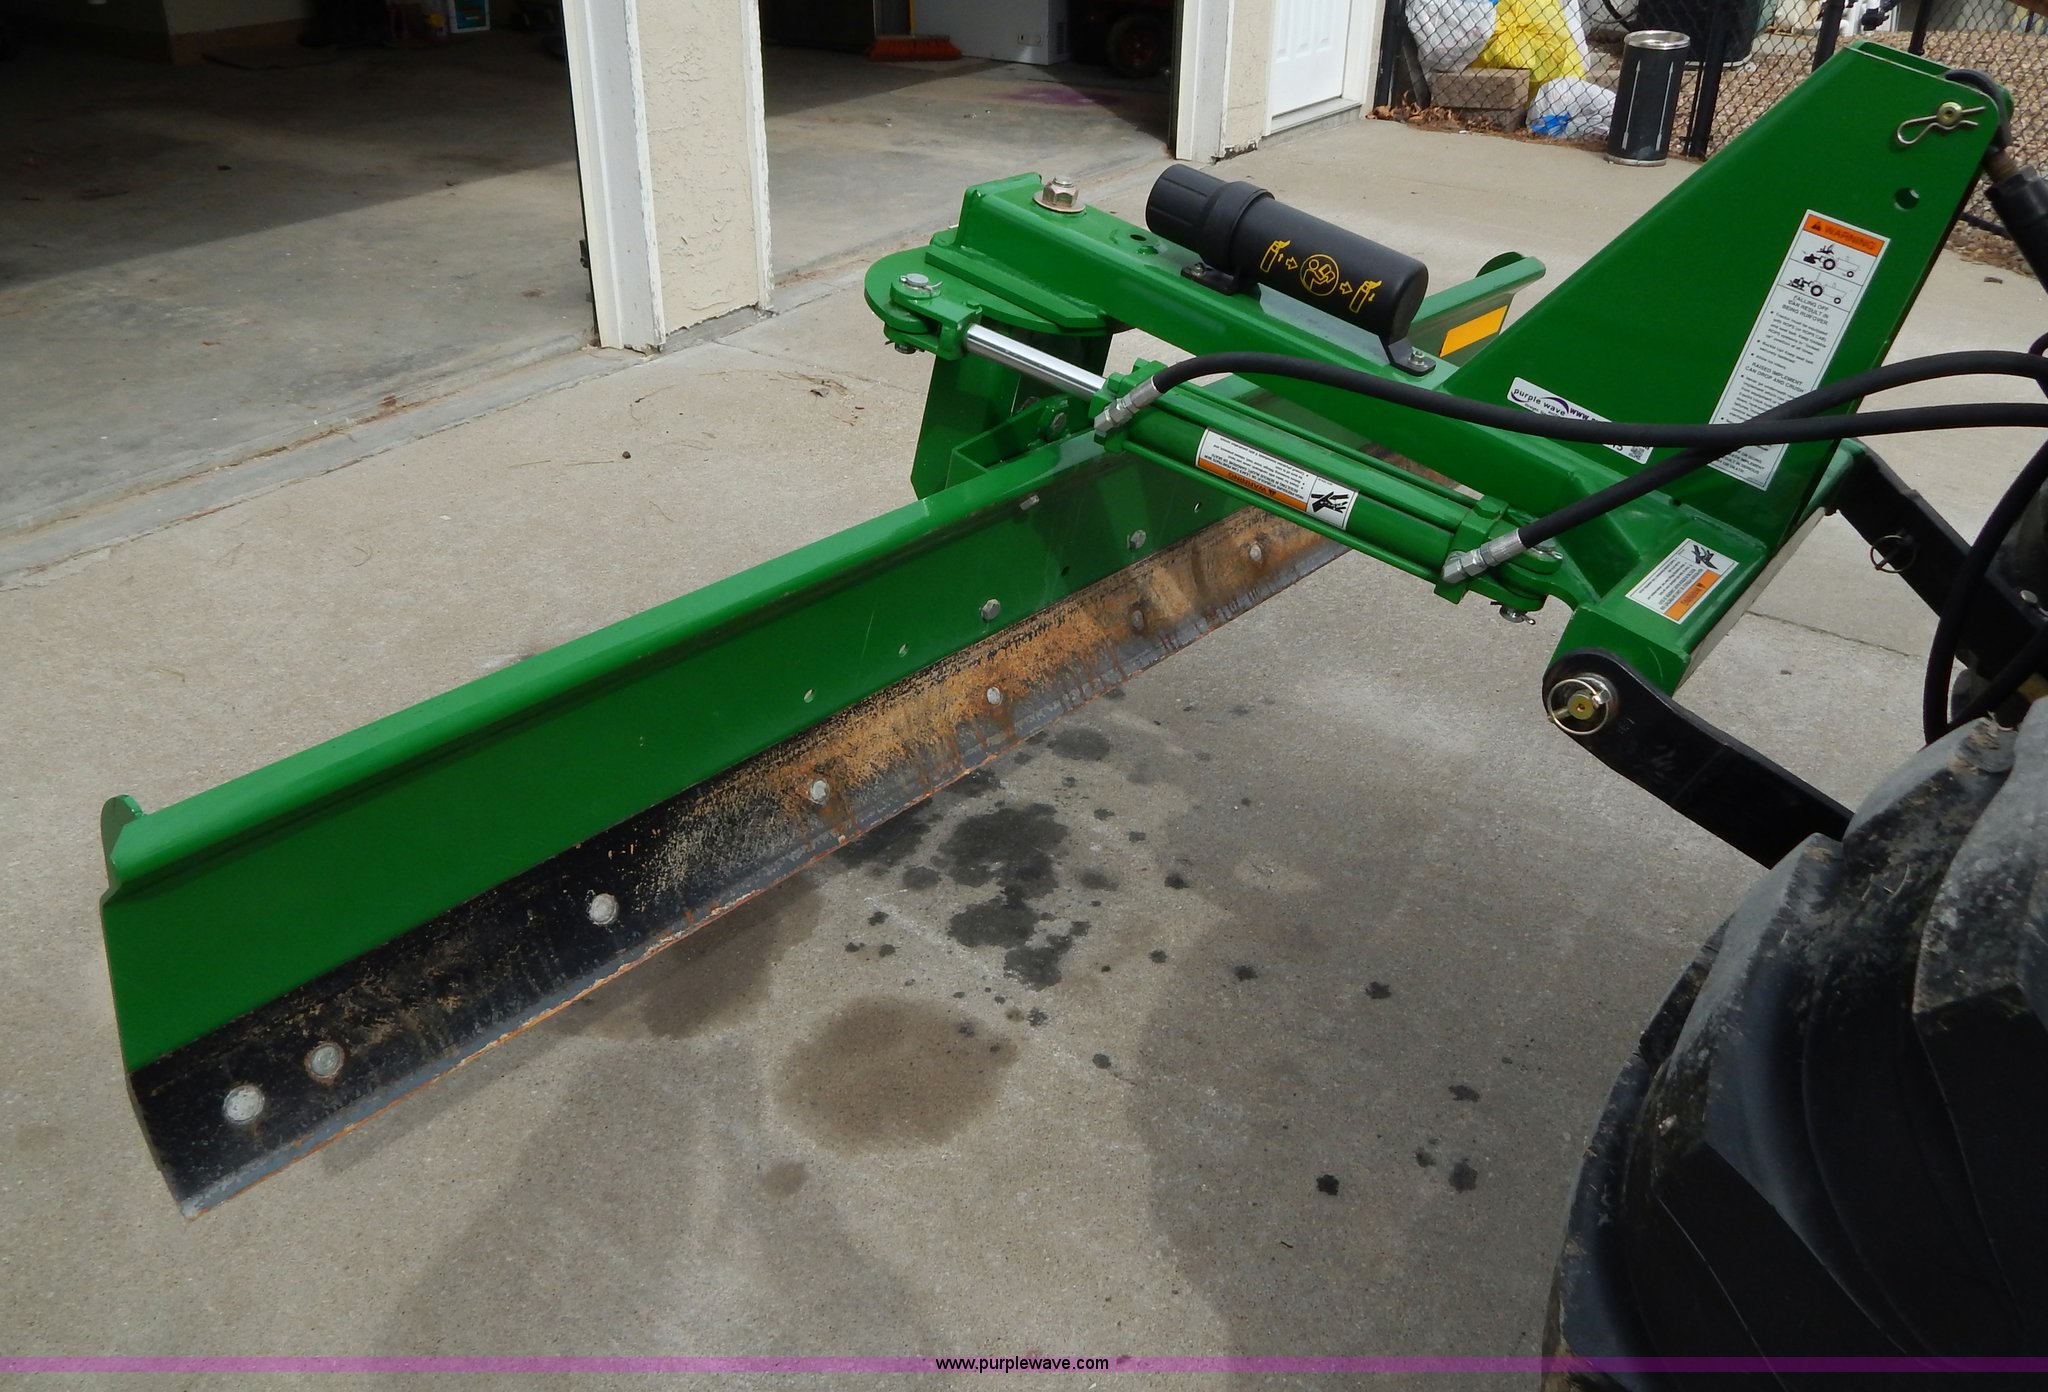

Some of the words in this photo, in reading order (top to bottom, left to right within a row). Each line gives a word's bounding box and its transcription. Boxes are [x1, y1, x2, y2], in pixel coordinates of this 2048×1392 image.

[1825, 226, 1875, 250] WARNING
[1513, 388, 1541, 405] purple
[1543, 401, 1566, 416] wave
